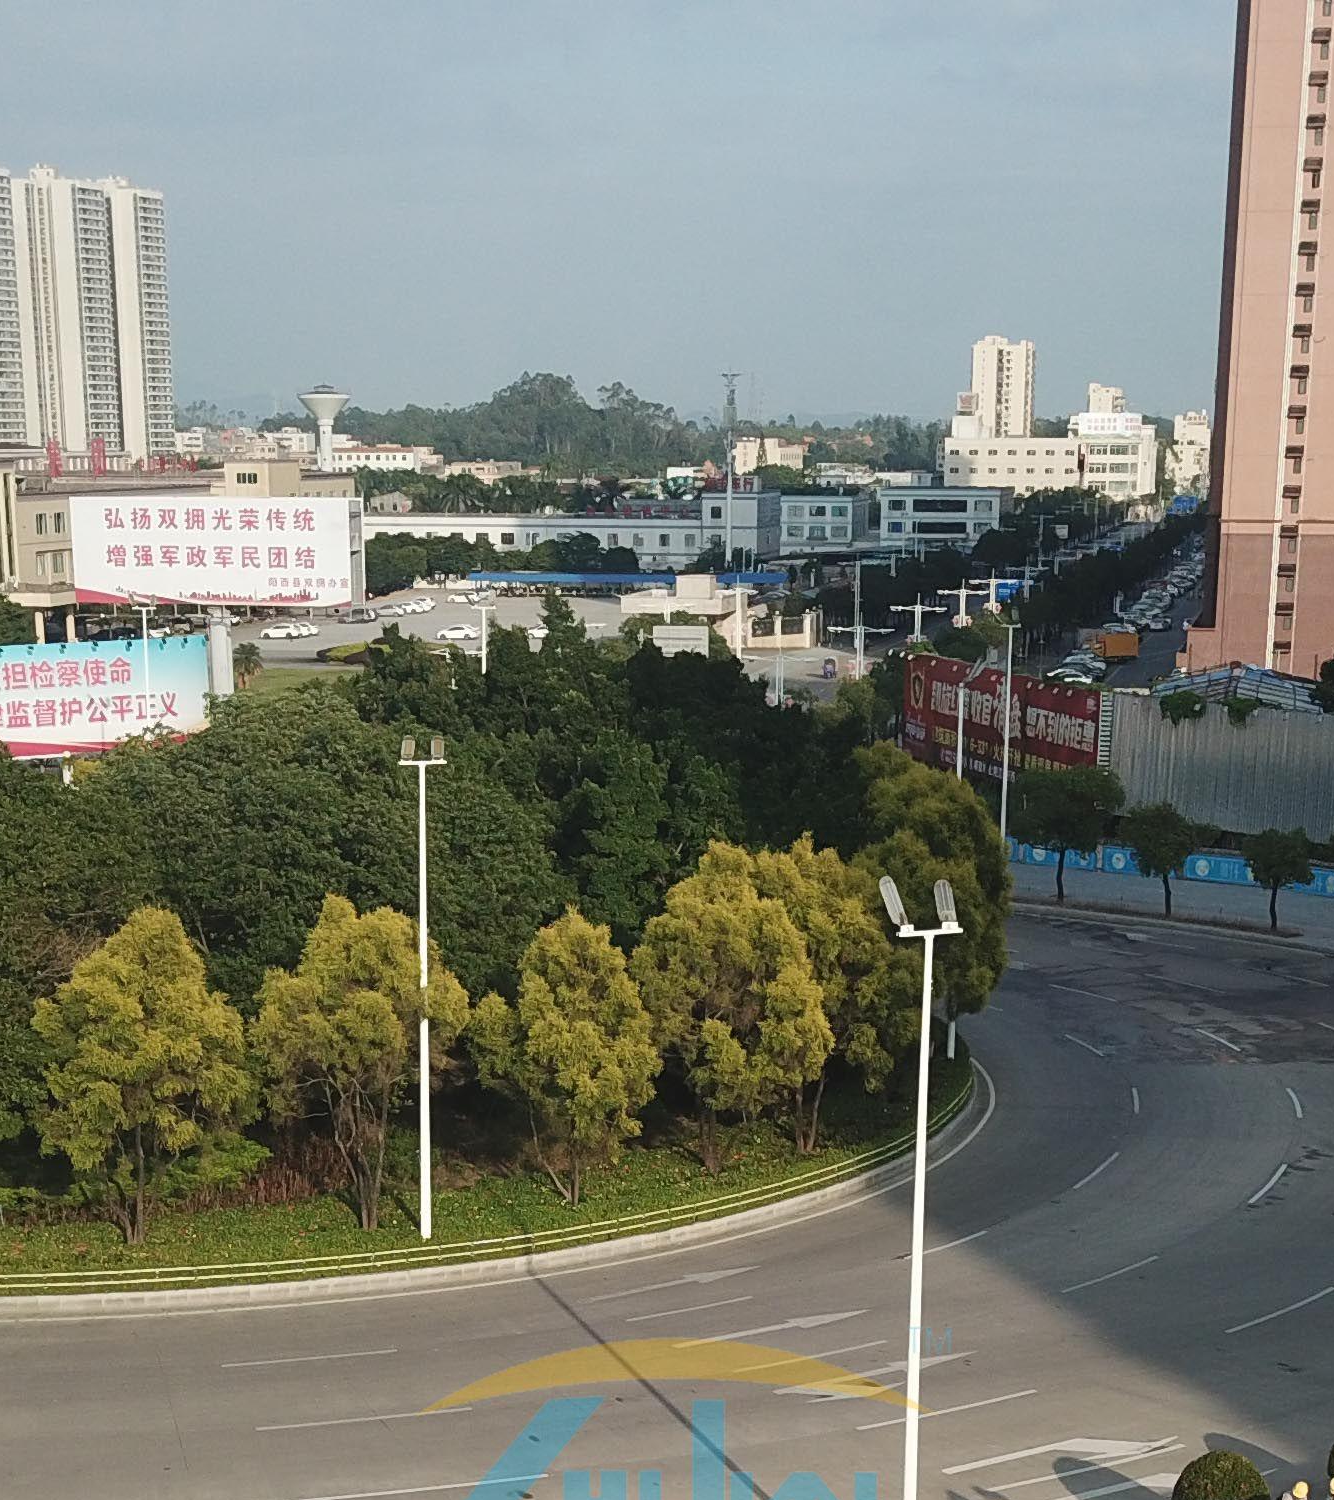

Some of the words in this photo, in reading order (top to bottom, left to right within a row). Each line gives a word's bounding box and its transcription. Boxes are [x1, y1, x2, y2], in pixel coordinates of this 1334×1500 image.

[104, 507, 315, 532] 弘扬双拥光荣传统
[106, 544, 316, 570] 增强军政军民团结
